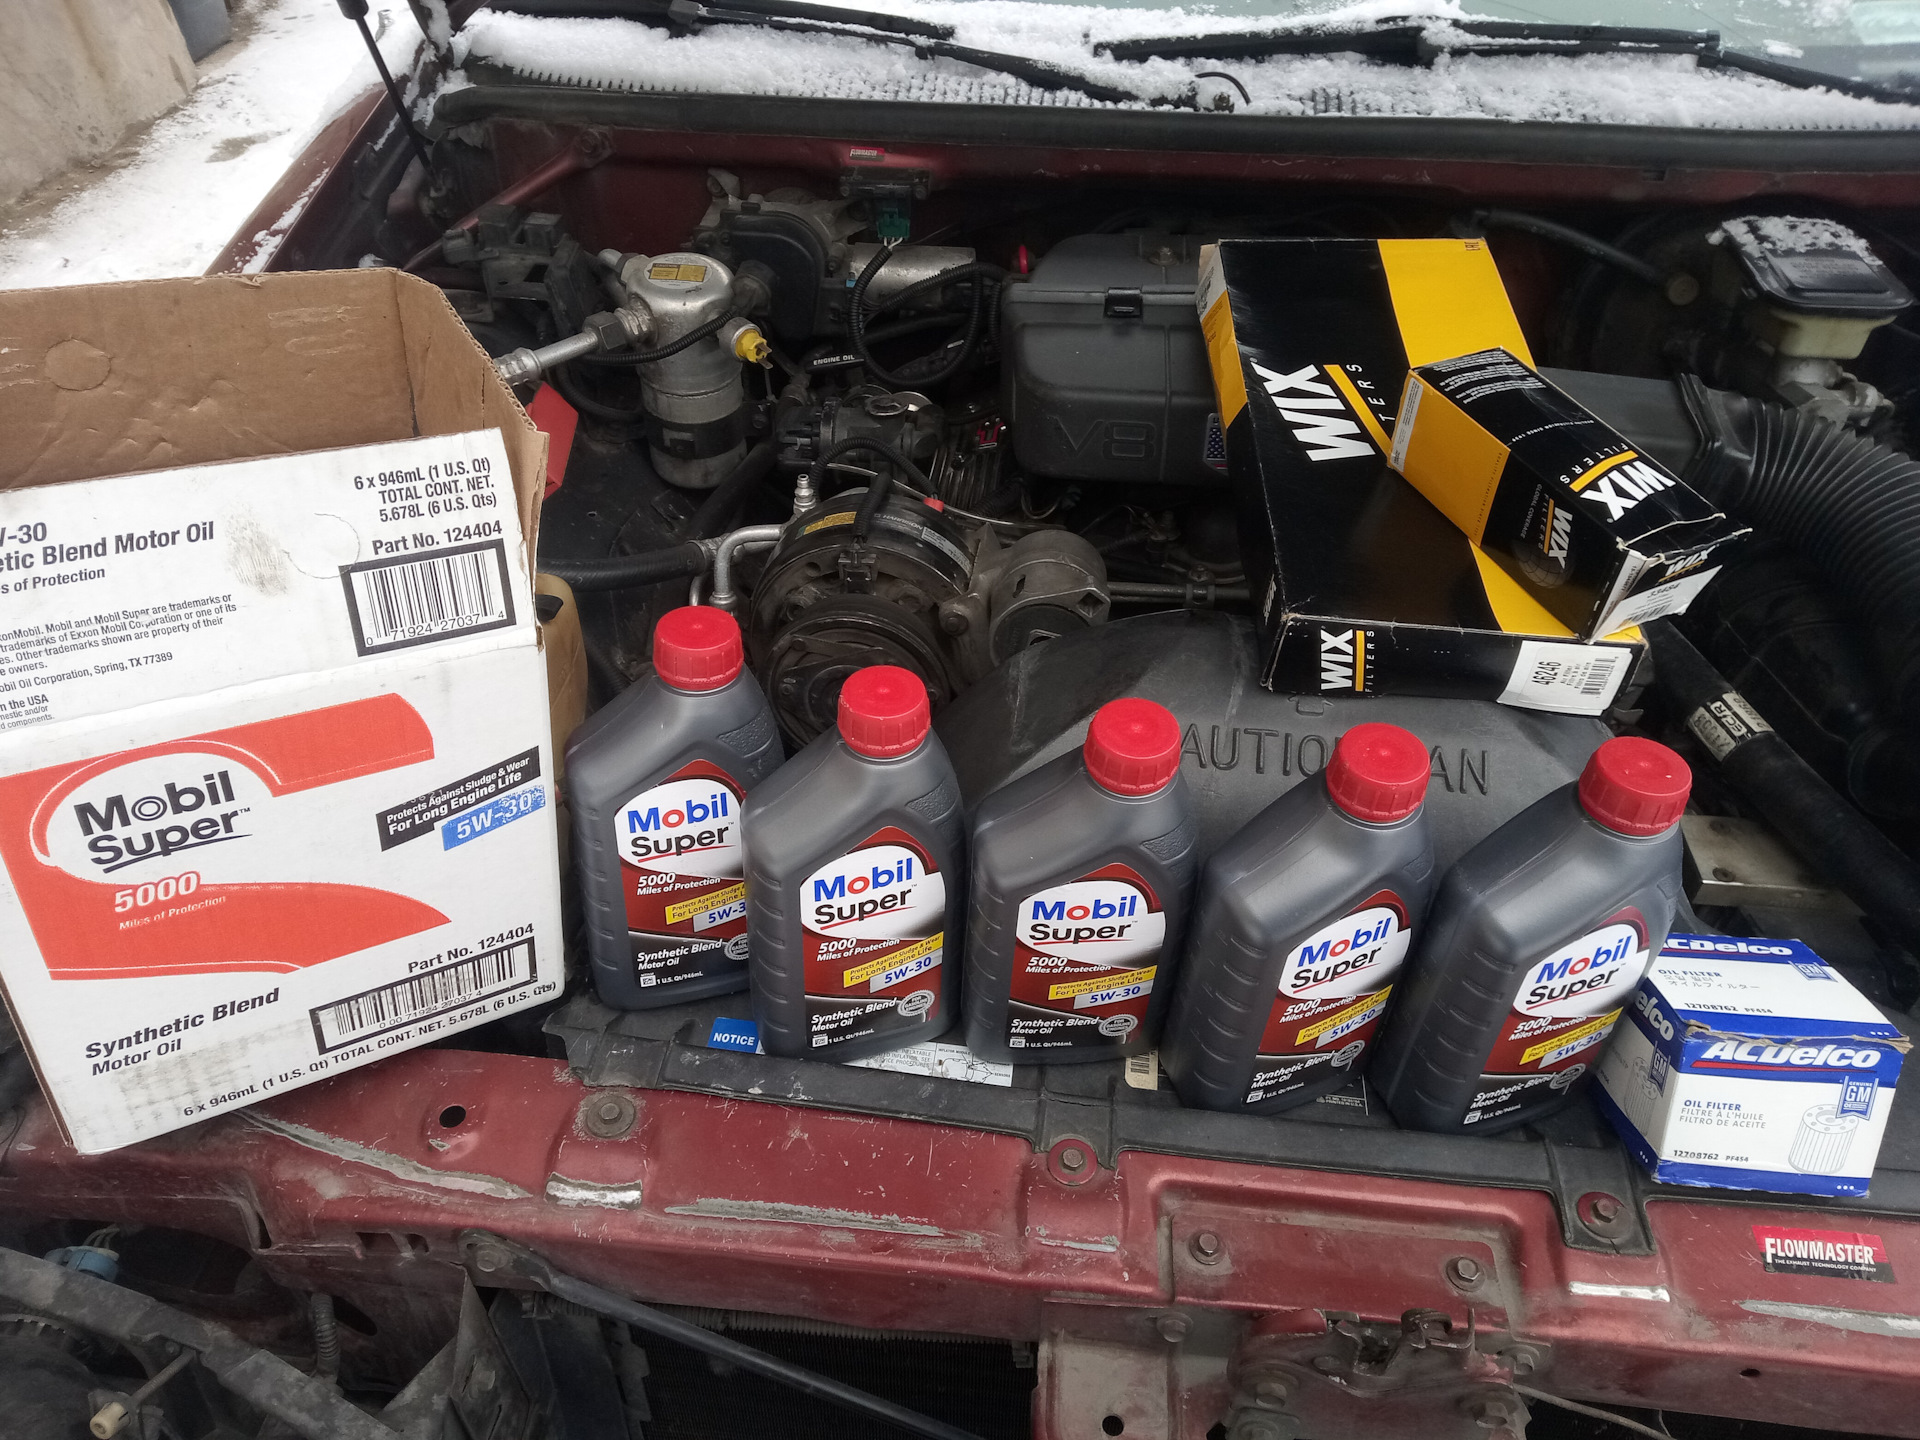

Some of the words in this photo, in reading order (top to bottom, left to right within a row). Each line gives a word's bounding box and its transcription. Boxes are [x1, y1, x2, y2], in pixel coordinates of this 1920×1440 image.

[813, 356, 840, 366] ENGINE
[1346, 364, 1396, 421] TERS
[1251, 364, 1376, 461] WIX
[1047, 415, 1158, 460] V8
[354, 475, 364, 490] 6
[366, 476, 377, 488] x
[379, 467, 426, 487] 946mL
[428, 465, 439, 482] (1
[444, 460, 470, 476] U.S.
[472, 457, 491, 474] Qt)
[1560, 443, 1629, 484] FILTERS
[378, 486, 422, 504] TOTAL
[425, 479, 464, 498] CONT.
[467, 475, 495, 491] NET.
[1531, 484, 1543, 507] GLOBAL
[1580, 460, 1677, 521] WIX
[379, 503, 425, 523] 5.678L
[428, 500, 440, 518] (6
[444, 496, 469, 513] U.S.
[472, 491, 497, 508] Qts)
[371, 535, 409, 555] Part
[413, 532, 440, 549] No.
[443, 520, 503, 543] 124404
[1520, 507, 1535, 539] COVERAGE
[1548, 506, 1573, 569] WIX
[42, 537, 107, 567] Blend
[115, 528, 180, 555] Motor
[186, 521, 214, 543] Oil
[14, 577, 29, 592] of
[32, 568, 106, 589] Protection
[1, 636, 56, 653] trademarks
[58, 632, 68, 642] of
[70, 628, 99, 640] Exxon
[101, 620, 127, 635] Mobil
[184, 611, 193, 620] or
[196, 608, 212, 618] one
[214, 604, 224, 615] of
[225, 603, 237, 612] its
[45, 620, 73, 634] Mobil
[75, 617, 92, 628] and
[94, 611, 121, 625] Mobil
[122, 608, 150, 620] Super
[151, 606, 167, 615] are
[168, 596, 220, 612] trademarks
[222, 594, 232, 603] or
[390, 623, 434, 641] 71924
[440, 613, 480, 631] 27037
[16, 650, 42, 662] Other
[44, 640, 100, 657] trademarks
[101, 634, 132, 647] shown
[135, 630, 150, 640] are
[151, 623, 190, 639] property
[193, 620, 202, 630] of
[203, 616, 224, 628] their
[9, 662, 48, 675] owners.
[19, 678, 32, 689] Oil
[34, 668, 93, 686] Corporation,
[94, 661, 128, 675] Spring,
[128, 657, 142, 668] TX
[143, 651, 173, 665] 77389
[1320, 629, 1353, 690] WIX
[1365, 630, 1376, 693] FILTERS
[1531, 661, 1562, 686] 46246
[8, 699, 26, 710] the
[27, 693, 50, 706] USA
[1180, 723, 1341, 777] AUTIO
[1430, 745, 1488, 796] AN
[74, 770, 235, 836] Mobil
[386, 802, 427, 824] Protects
[428, 785, 465, 808] Against
[465, 772, 497, 791] Sludge
[497, 767, 506, 777] &
[506, 757, 530, 773] Wear
[388, 818, 413, 836] For
[414, 806, 449, 826] Long
[450, 785, 496, 810] Engine
[498, 771, 522, 789] Life
[457, 793, 532, 840] 5W-30
[627, 793, 729, 834] Mobil
[114, 872, 199, 913] 5000
[637, 872, 676, 888] 5000
[637, 886, 662, 896] Miles
[663, 883, 674, 893] of
[674, 877, 721, 890] Protection
[814, 858, 913, 902] Mobil
[708, 902, 746, 924] 5W-3
[1032, 895, 1137, 920] Mobil
[407, 956, 443, 974] Part
[447, 946, 474, 962] No.
[478, 923, 534, 951] 124404
[637, 945, 689, 962] Synthetic
[691, 938, 723, 953] Blend
[816, 952, 842, 962] Miles
[843, 949, 854, 957] of
[854, 939, 900, 955] Protection
[818, 937, 857, 954] 5000
[1297, 917, 1392, 967] Mobil
[638, 961, 665, 971] Motor
[667, 957, 680, 965] Oil
[865, 965, 886, 976] Long
[888, 953, 916, 967] Engine
[884, 957, 932, 984] 5W-30
[1028, 957, 1068, 966] 5000
[1535, 935, 1633, 984] Mobil
[1682, 970, 1722, 978] FILTER
[1089, 985, 1141, 1004] 5W-30
[1284, 998, 1322, 1015] 5000
[1684, 1002, 1739, 1011] 12708762
[86, 1013, 205, 1060] Synthetic
[212, 987, 280, 1022] Blend
[811, 1007, 863, 1025] Synthetic
[865, 997, 897, 1013] Blend
[811, 1021, 839, 1032] Motor
[840, 1018, 853, 1027] Oil
[1330, 1009, 1376, 1039] 5W-30
[1514, 1015, 1553, 1033] 5000
[712, 1032, 755, 1046] NOTICE
[1554, 1031, 1603, 1060] 5W-30
[92, 1050, 151, 1077] Motor
[156, 1038, 182, 1056] Oil
[183, 1106, 194, 1116] 6
[197, 1103, 206, 1112] x
[209, 1084, 259, 1107] 946mL
[262, 1078, 274, 1090] (1
[279, 1068, 306, 1083] U.S.
[309, 1059, 329, 1073] Qt)
[331, 1044, 375, 1064] TOTAL
[377, 1029, 416, 1049] CONT.
[418, 1020, 446, 1036] NET.
[449, 1006, 490, 1026] 5.678L
[493, 999, 506, 1012] (6
[1684, 1100, 1702, 1108] OIL
[1706, 1102, 1741, 1111] FILTER
[1845, 1086, 1872, 1102] GM
[1679, 1116, 1713, 1125] FILTRO
[1716, 1119, 1729, 1127] DE
[1732, 1120, 1766, 1129] ACEITE
[1681, 1108, 1712, 1117] FILTRE
[1726, 1111, 1764, 1121] L'HUILE
[1673, 1150, 1719, 1160] 12708762
[1765, 1237, 1875, 1265] FLOWMASTER
[1786, 1259, 1810, 1267] EXHAUST
[1812, 1262, 1849, 1270] TECHNOLOGY
[1849, 1265, 1877, 1273] COMPANY
